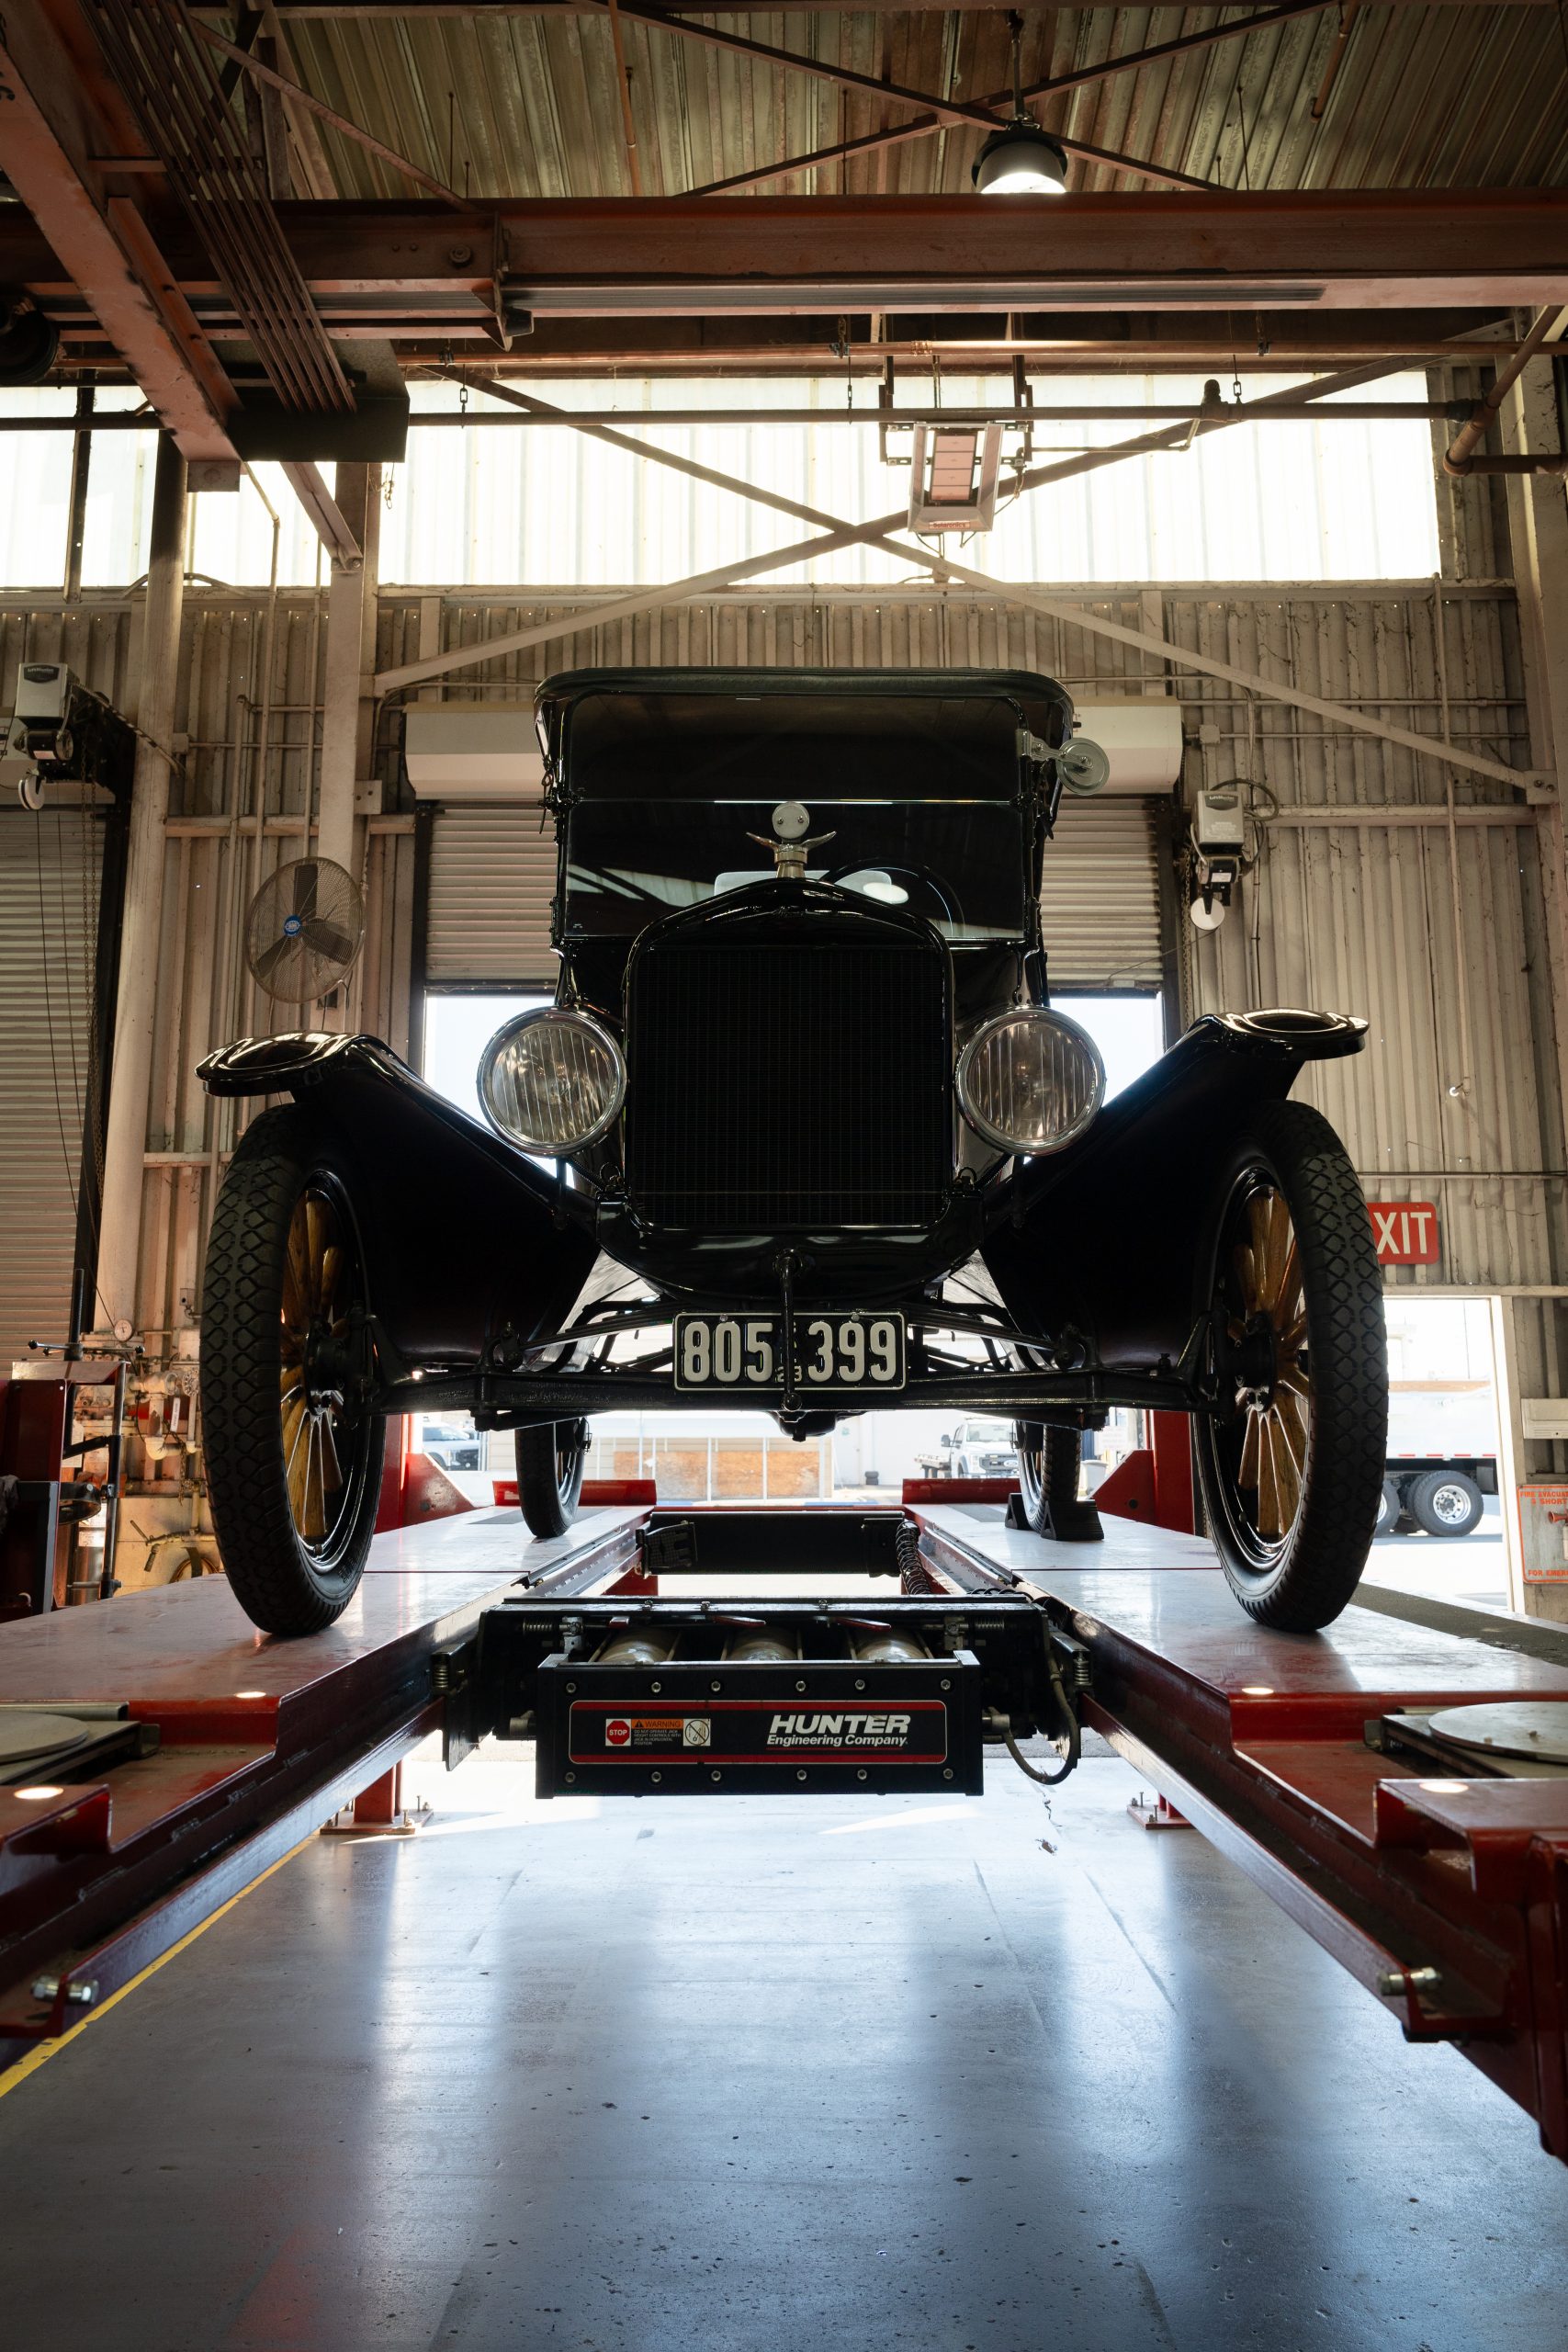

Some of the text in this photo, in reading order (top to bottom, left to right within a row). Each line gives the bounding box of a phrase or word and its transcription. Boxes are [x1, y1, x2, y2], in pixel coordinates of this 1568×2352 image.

[1372, 1212, 1432, 1255] XIT
[683, 1321, 773, 1382] 805
[807, 1321, 897, 1382] 399
[769, 1714, 911, 1734] HUNTER
[767, 1735, 842, 1747] Engineering
